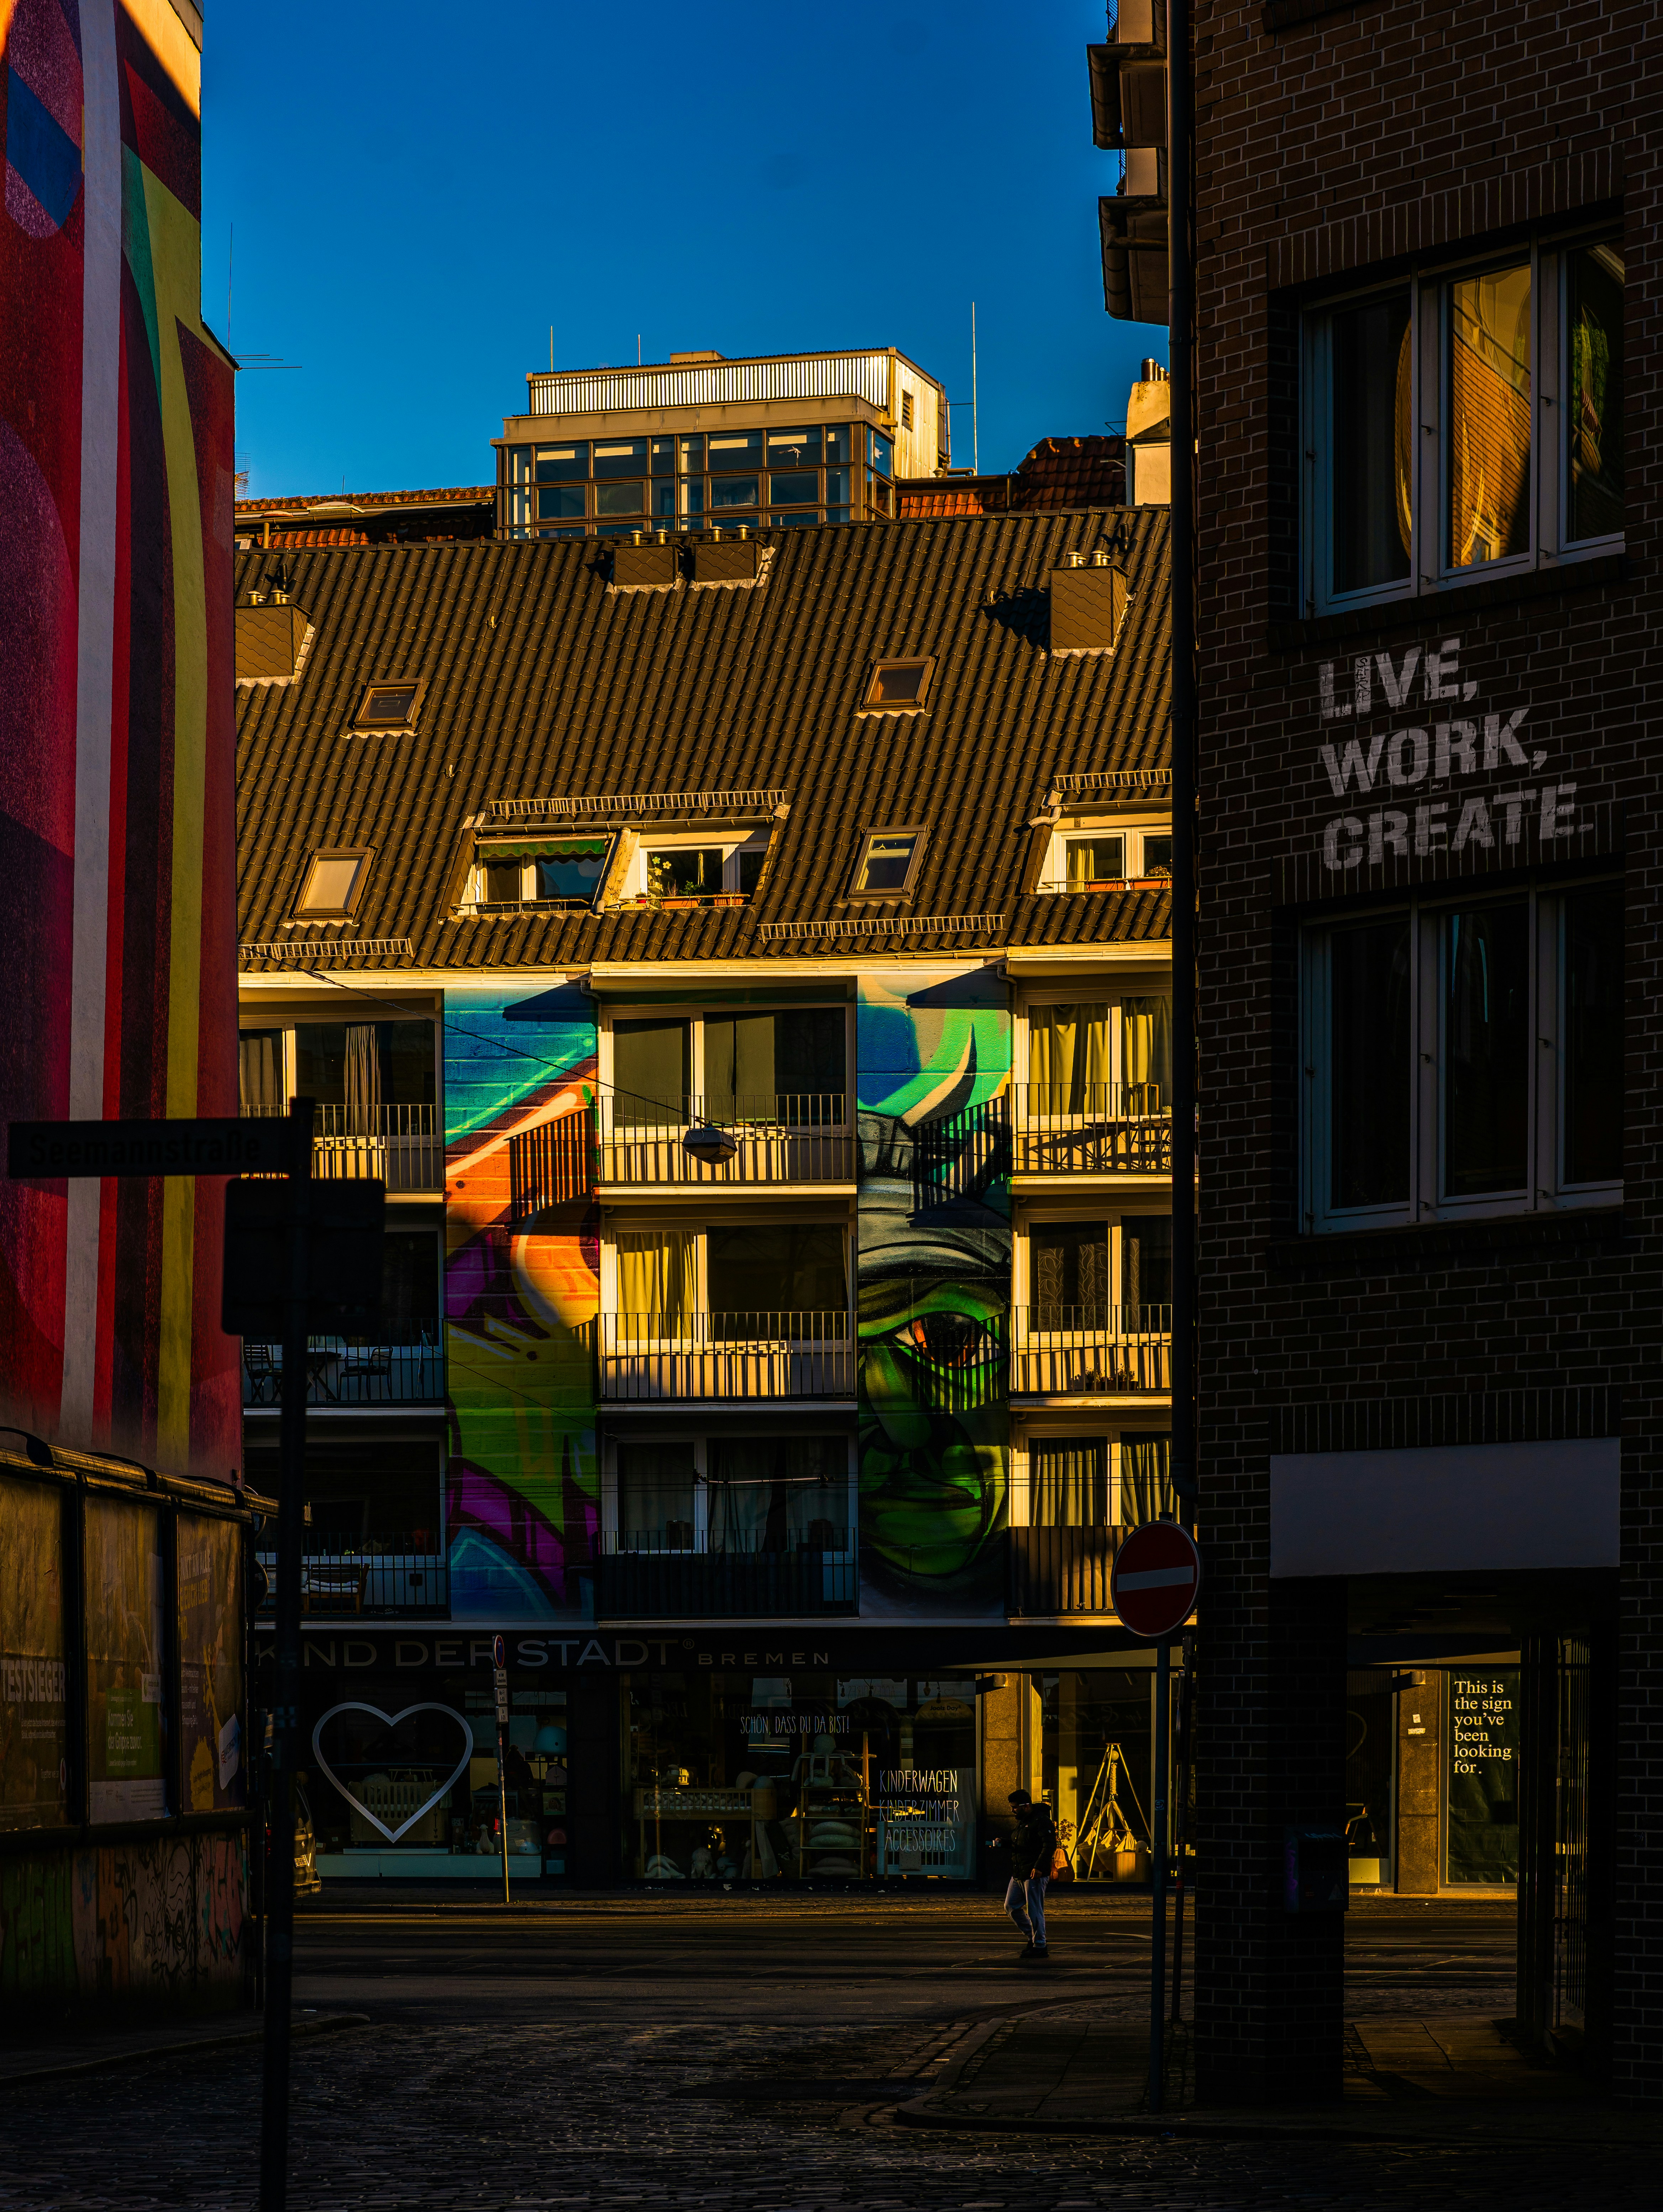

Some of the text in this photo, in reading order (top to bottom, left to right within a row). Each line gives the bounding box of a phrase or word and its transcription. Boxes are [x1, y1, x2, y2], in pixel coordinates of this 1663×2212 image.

[1319, 638, 1477, 720] LIVE,
[1320, 708, 1547, 797] WORK,
[1323, 782, 1594, 870] CREATE.
[30, 1130, 261, 1166] Seemannstraße
[256, 1639, 377, 1668] KND
[395, 1639, 494, 1668] DER
[698, 1653, 829, 1665] BREMEN
[1, 1659, 66, 1703] TESTSIEGER
[1454, 1680, 1504, 1694] This is
[1454, 1696, 1512, 1712] the sign
[108, 1708, 126, 1727] Kommen
[740, 1711, 771, 1736] SCHÖN,
[775, 1715, 797, 1734] DASS
[799, 1715, 811, 1734] DU
[814, 1715, 827, 1734] DA
[829, 1715, 849, 1734] BIST!
[1454, 1713, 1504, 1729] you've
[115, 1731, 129, 1754] Grippe
[130, 1736, 142, 1749] zuvor.
[1455, 1729, 1489, 1742] been
[1454, 1744, 1512, 1761] looking
[879, 1769, 958, 1793] KINDERWAGEN
[879, 1799, 960, 1822] KINDERZIMMER
[884, 1829, 956, 1852] ACCESSOIRES
